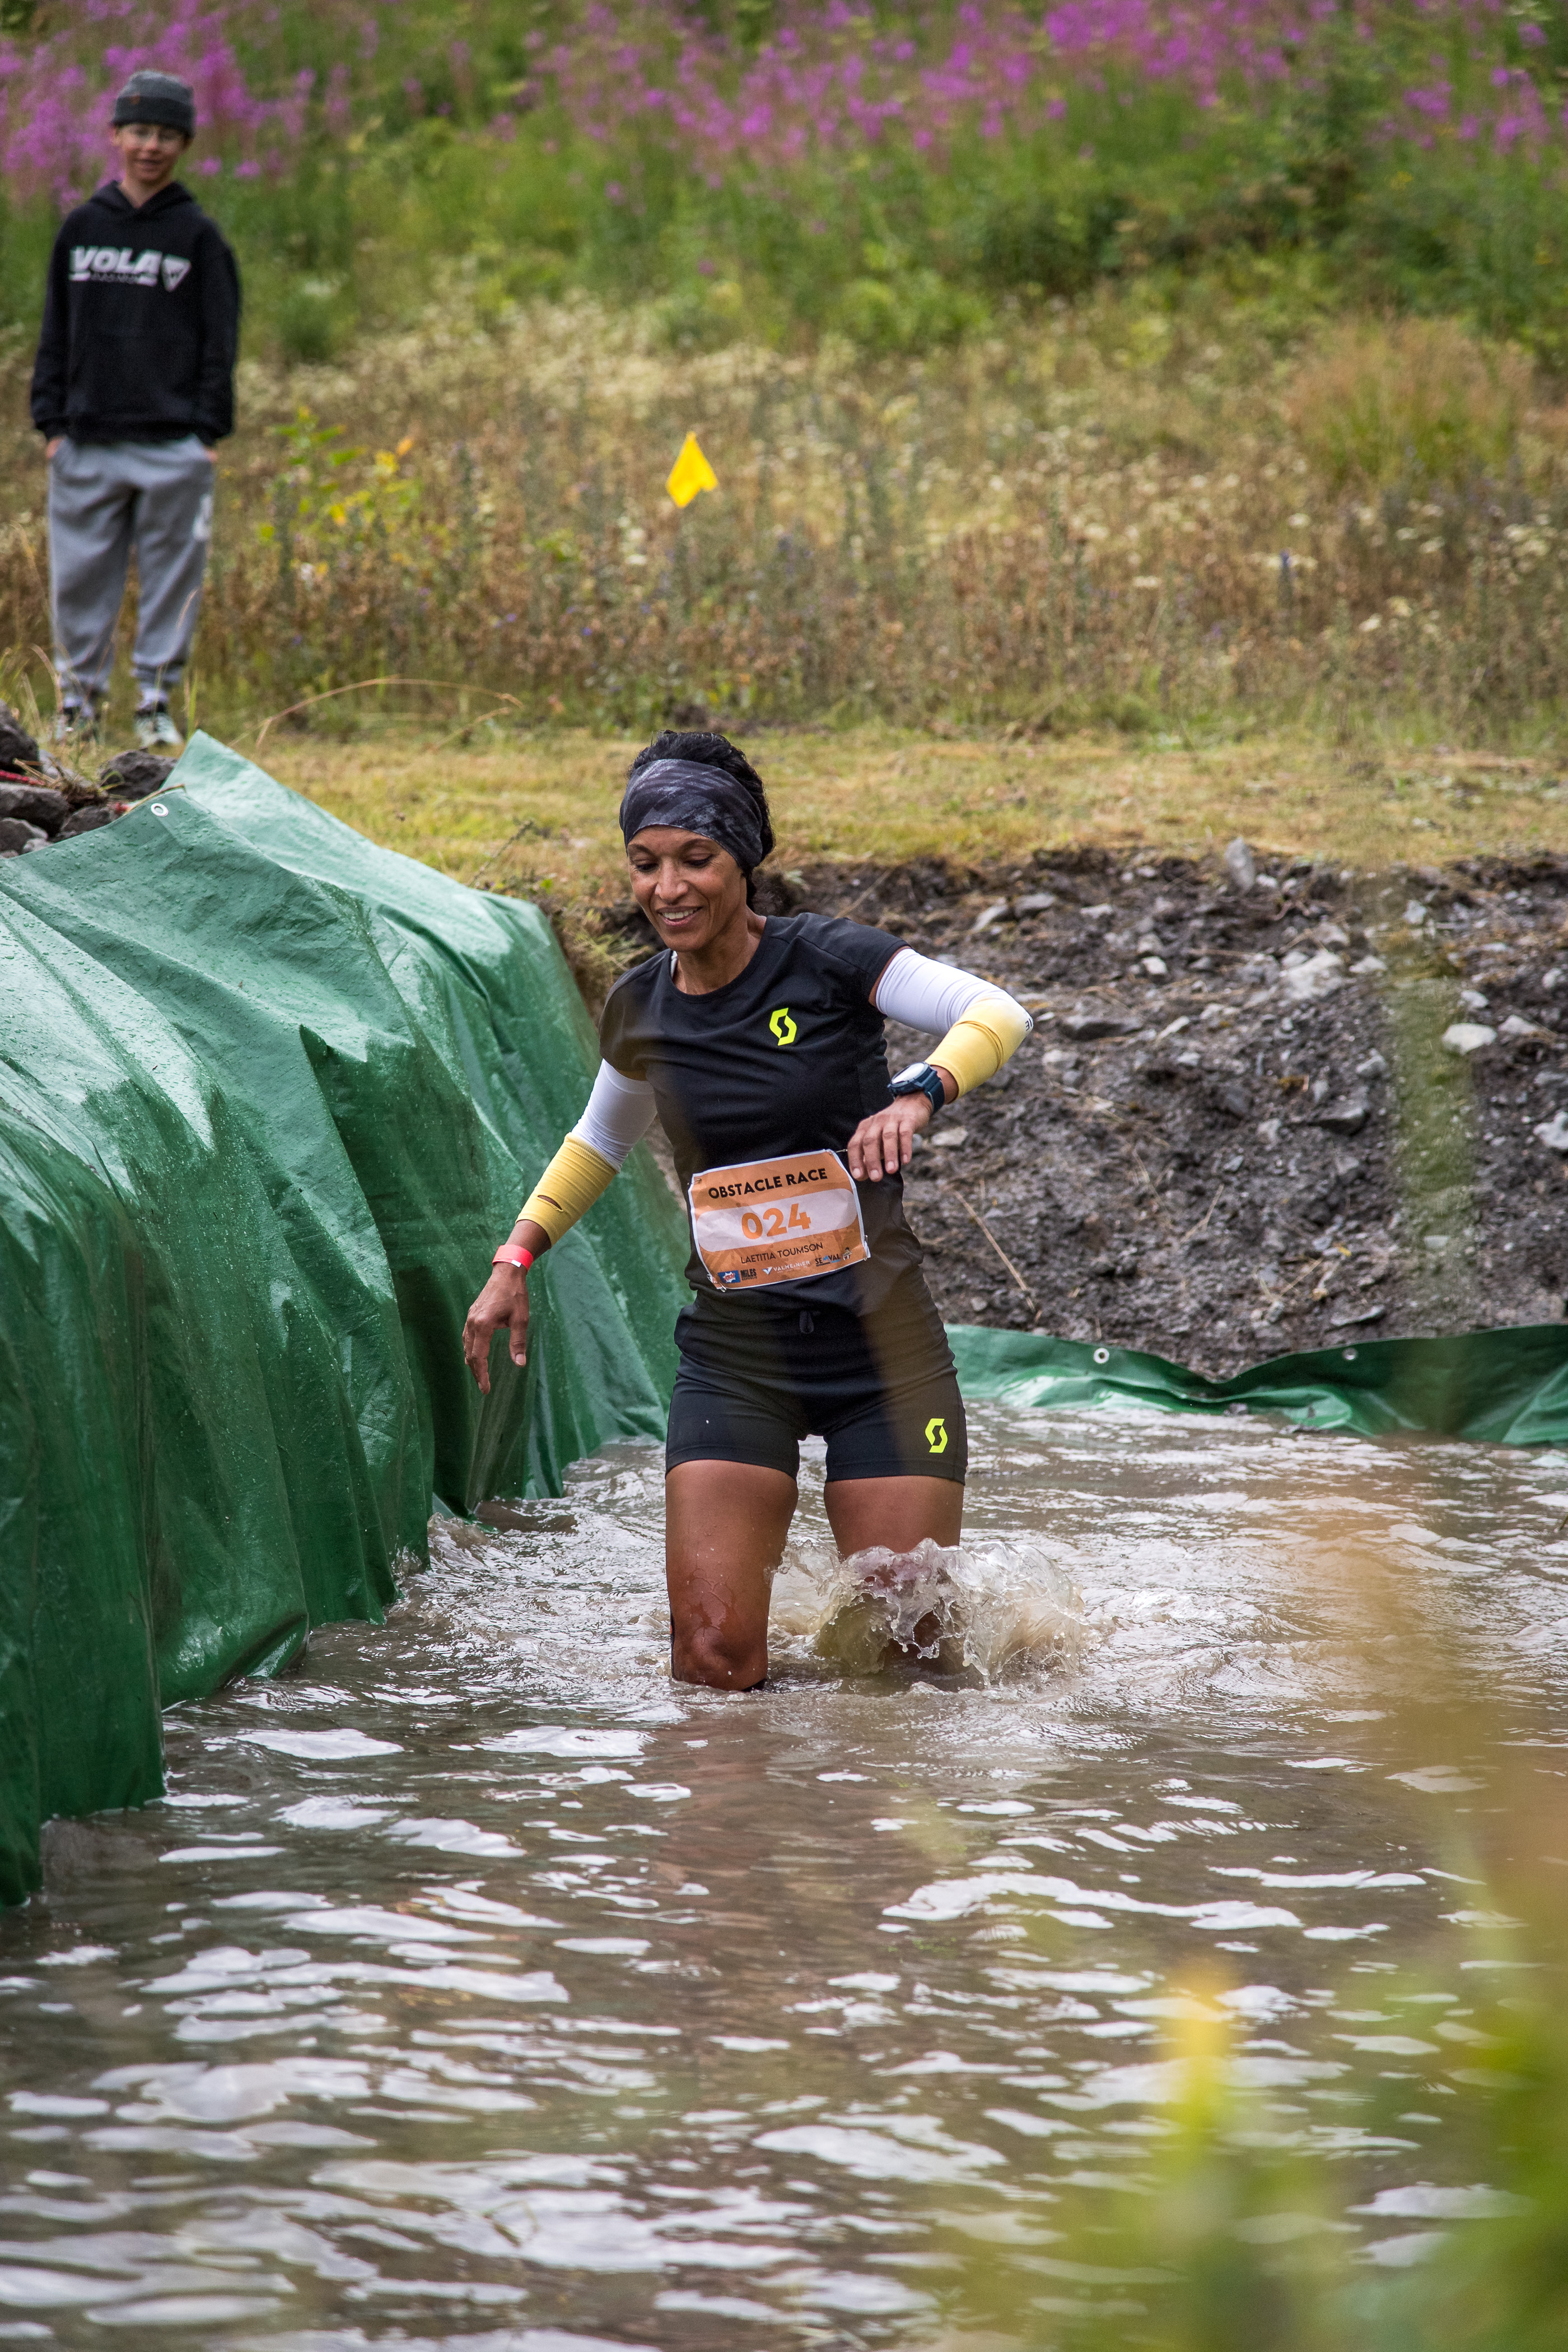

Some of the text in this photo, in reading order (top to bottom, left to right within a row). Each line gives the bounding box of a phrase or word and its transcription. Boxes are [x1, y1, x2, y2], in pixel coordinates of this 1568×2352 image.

[70, 245, 162, 274] VOLA
[708, 1168, 828, 1199] OBSTACLE RACE
[741, 1203, 811, 1239] 024
[740, 1242, 823, 1264] LAETITIA TOUMSON
